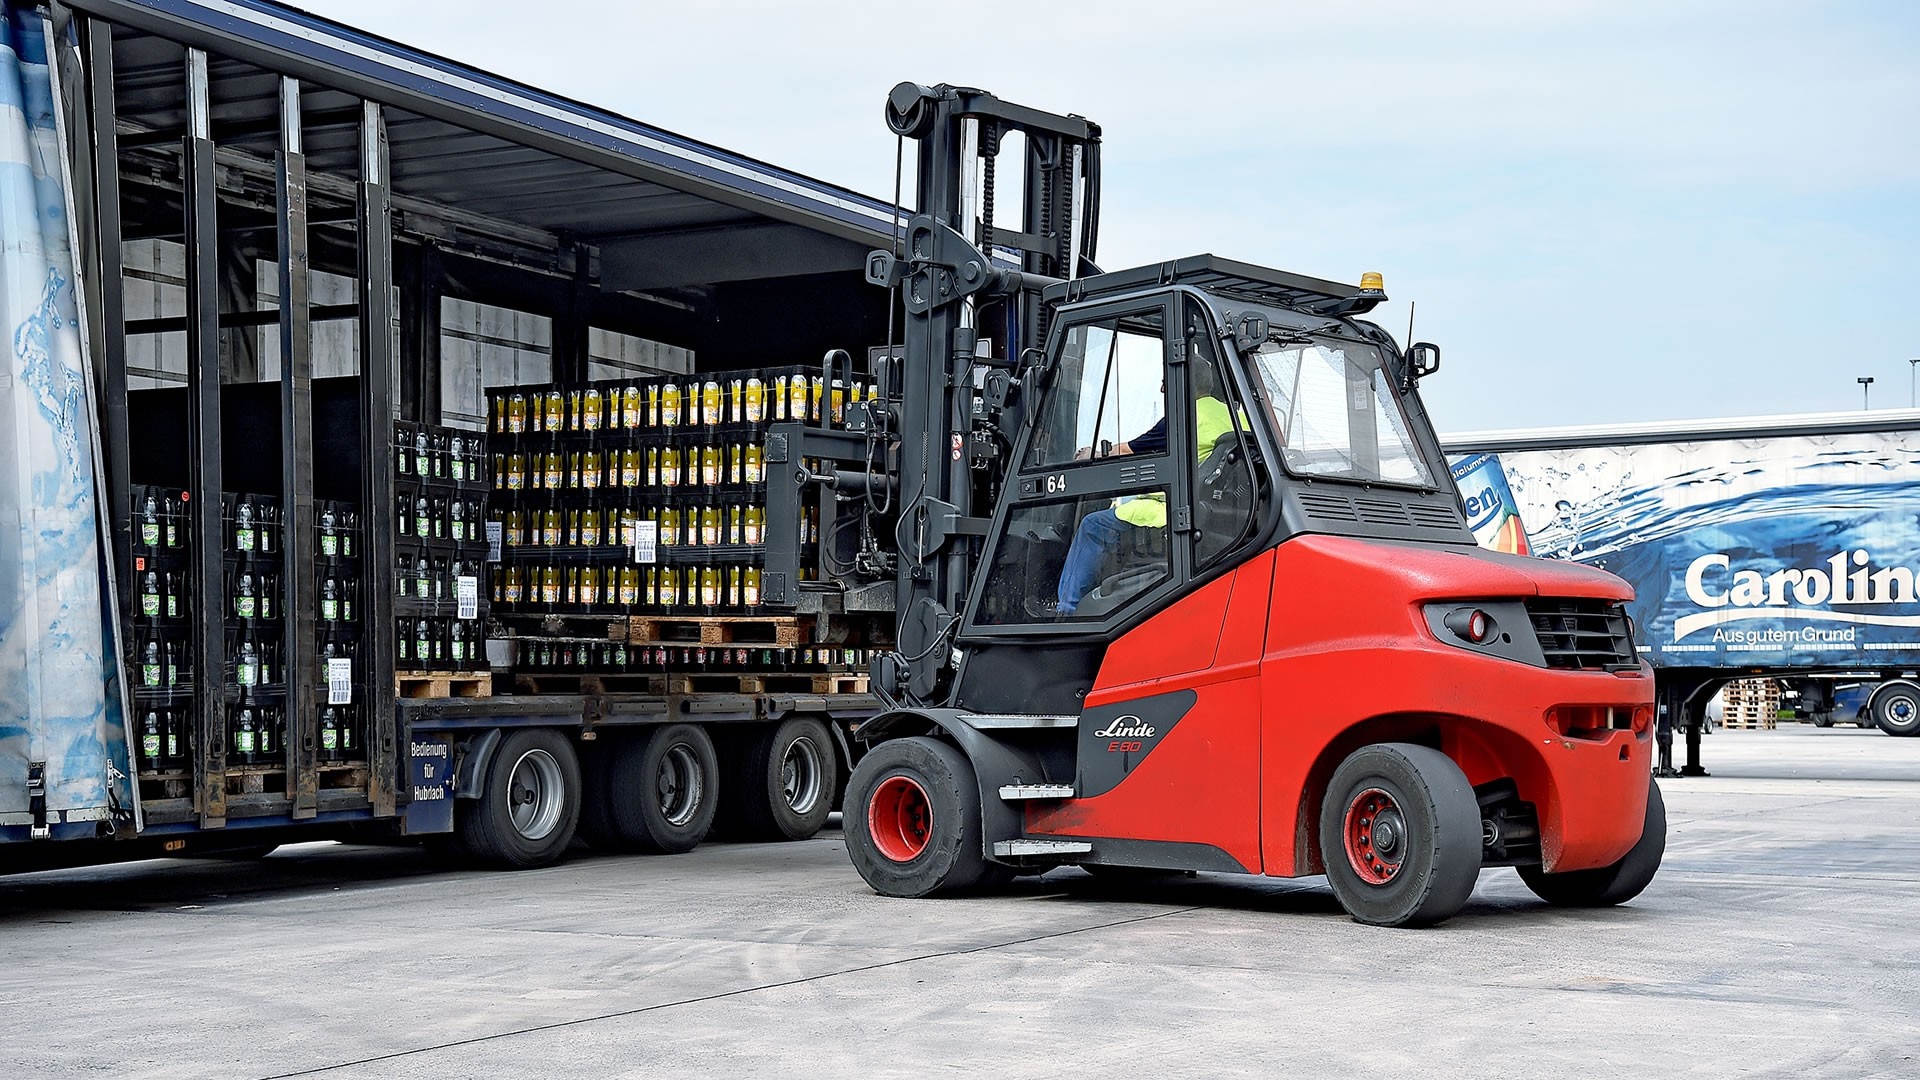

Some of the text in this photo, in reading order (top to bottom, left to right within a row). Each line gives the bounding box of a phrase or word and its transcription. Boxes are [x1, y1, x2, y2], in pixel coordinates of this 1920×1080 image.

[1047, 474, 1066, 493] 64
[1465, 487, 1498, 517] en
[1684, 549, 1920, 607] Carolin
[1712, 626, 1855, 645] Aus gutem Grund
[1094, 715, 1156, 737] Linde
[411, 741, 447, 759] Bedienung
[424, 763, 434, 778] für
[414, 785, 444, 801] Hubdach
